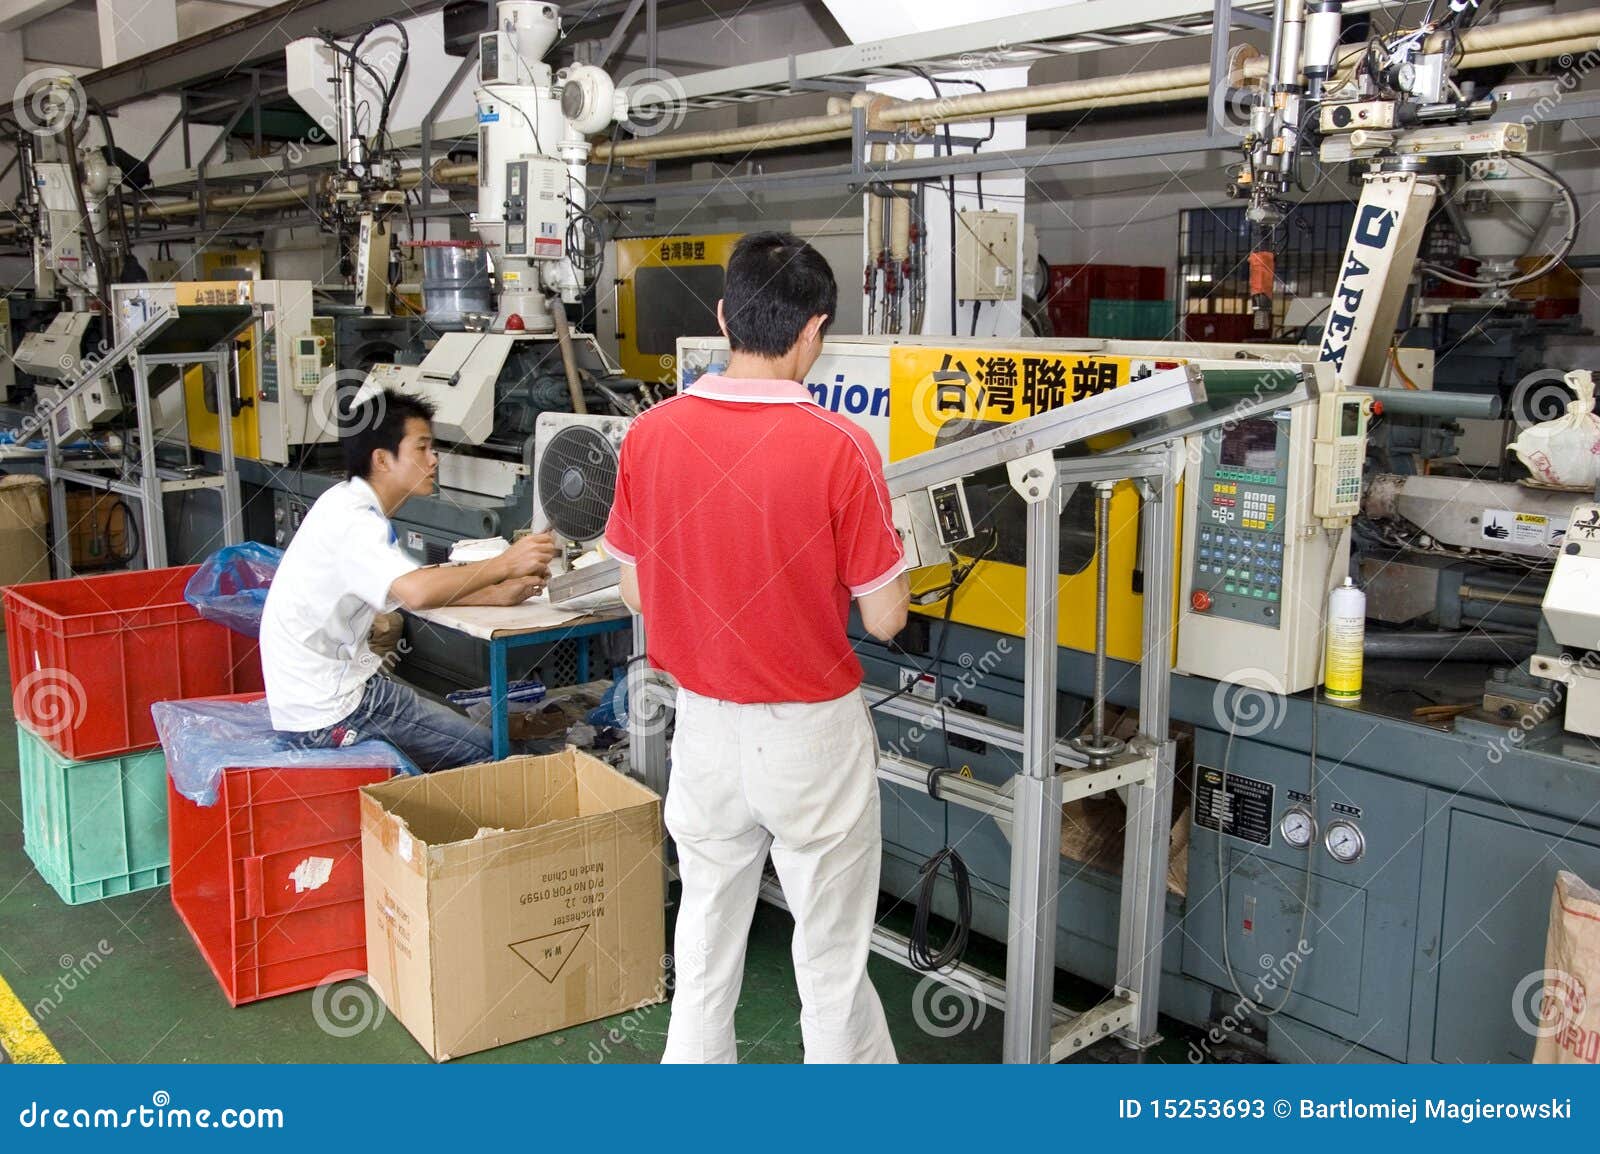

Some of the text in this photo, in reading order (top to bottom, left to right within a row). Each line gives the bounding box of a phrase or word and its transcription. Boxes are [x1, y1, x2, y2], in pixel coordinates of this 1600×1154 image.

[1320, 250, 1370, 373] APEX
[541, 869, 568, 884] China
[579, 861, 605, 875] Made
[552, 907, 606, 927] Manchester
